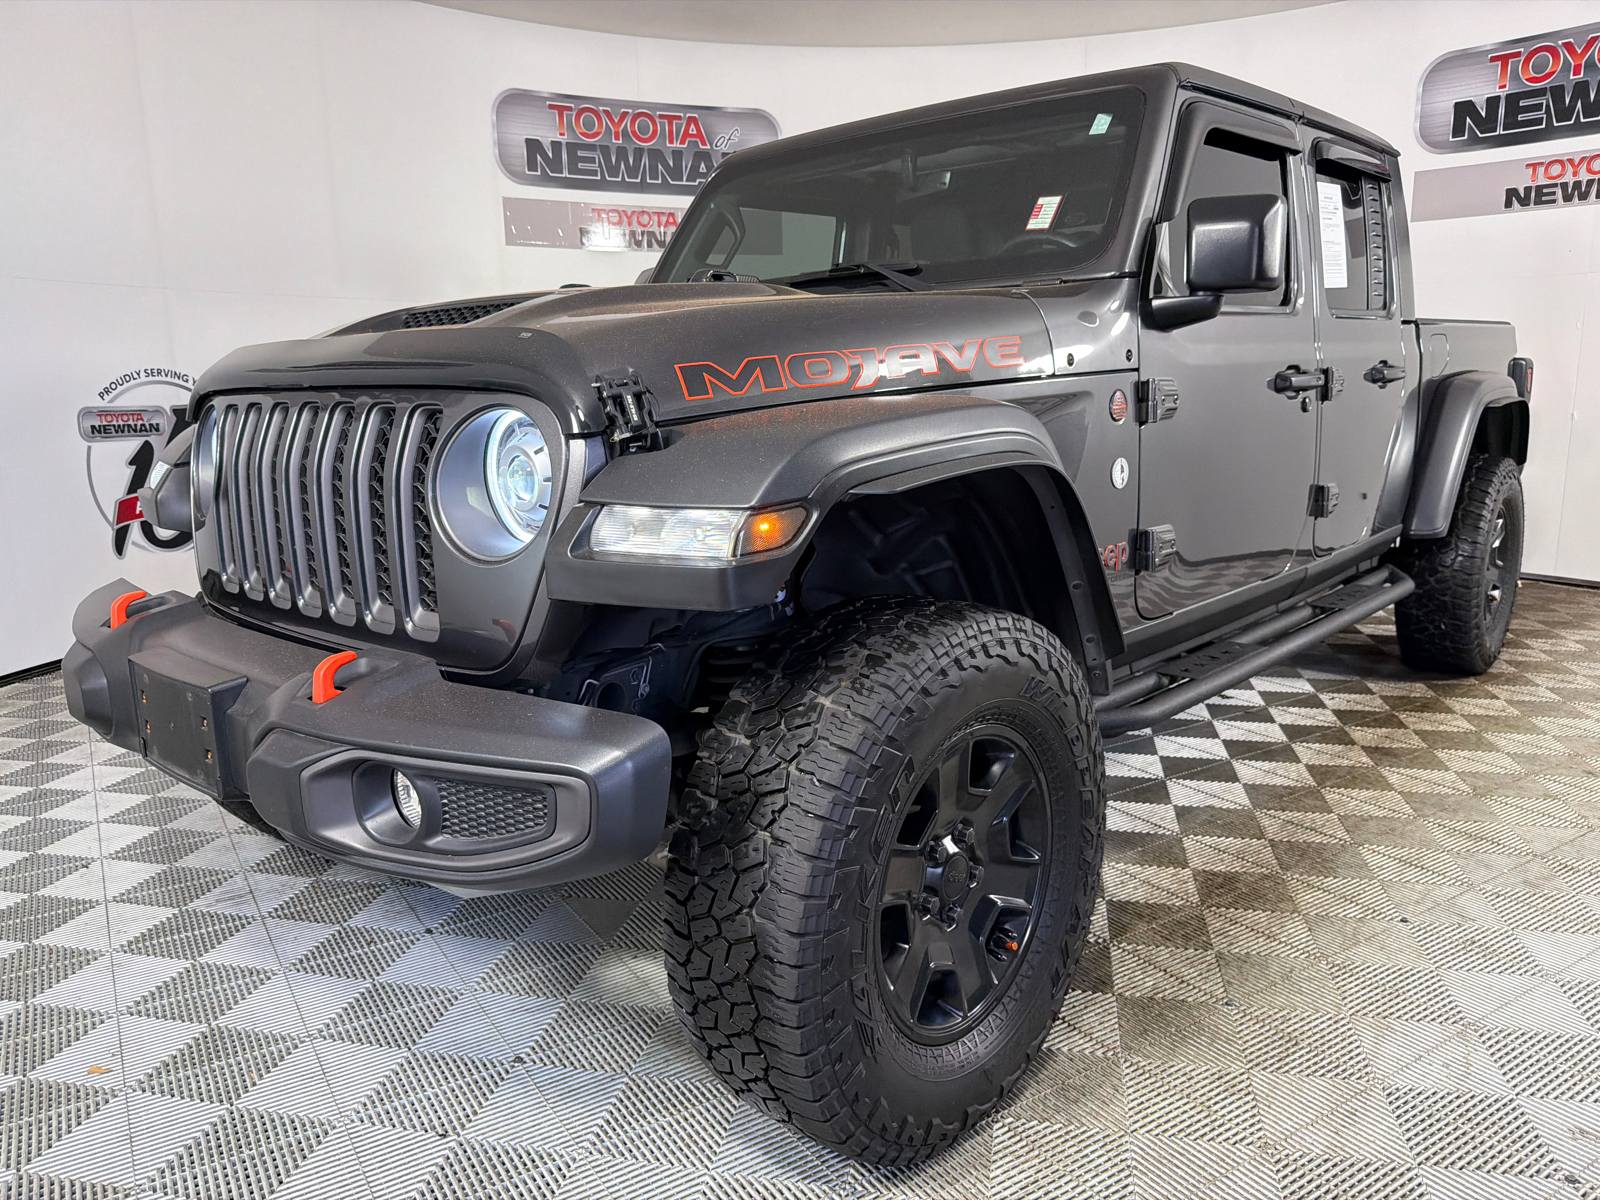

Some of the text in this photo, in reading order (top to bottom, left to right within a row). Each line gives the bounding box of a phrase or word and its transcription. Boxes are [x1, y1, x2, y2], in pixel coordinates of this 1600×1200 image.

[1488, 34, 1600, 91] TOY
[547, 102, 740, 149] TOYOTA of
[524, 137, 738, 184] NEWNA
[591, 207, 680, 229] TOYOTA
[97, 369, 142, 401] PROUDLY
[143, 368, 190, 383] SERVING
[674, 335, 1026, 400] MOJAVE
[90, 422, 160, 435] NEWNAN
[96, 412, 145, 423] TOYOTA
